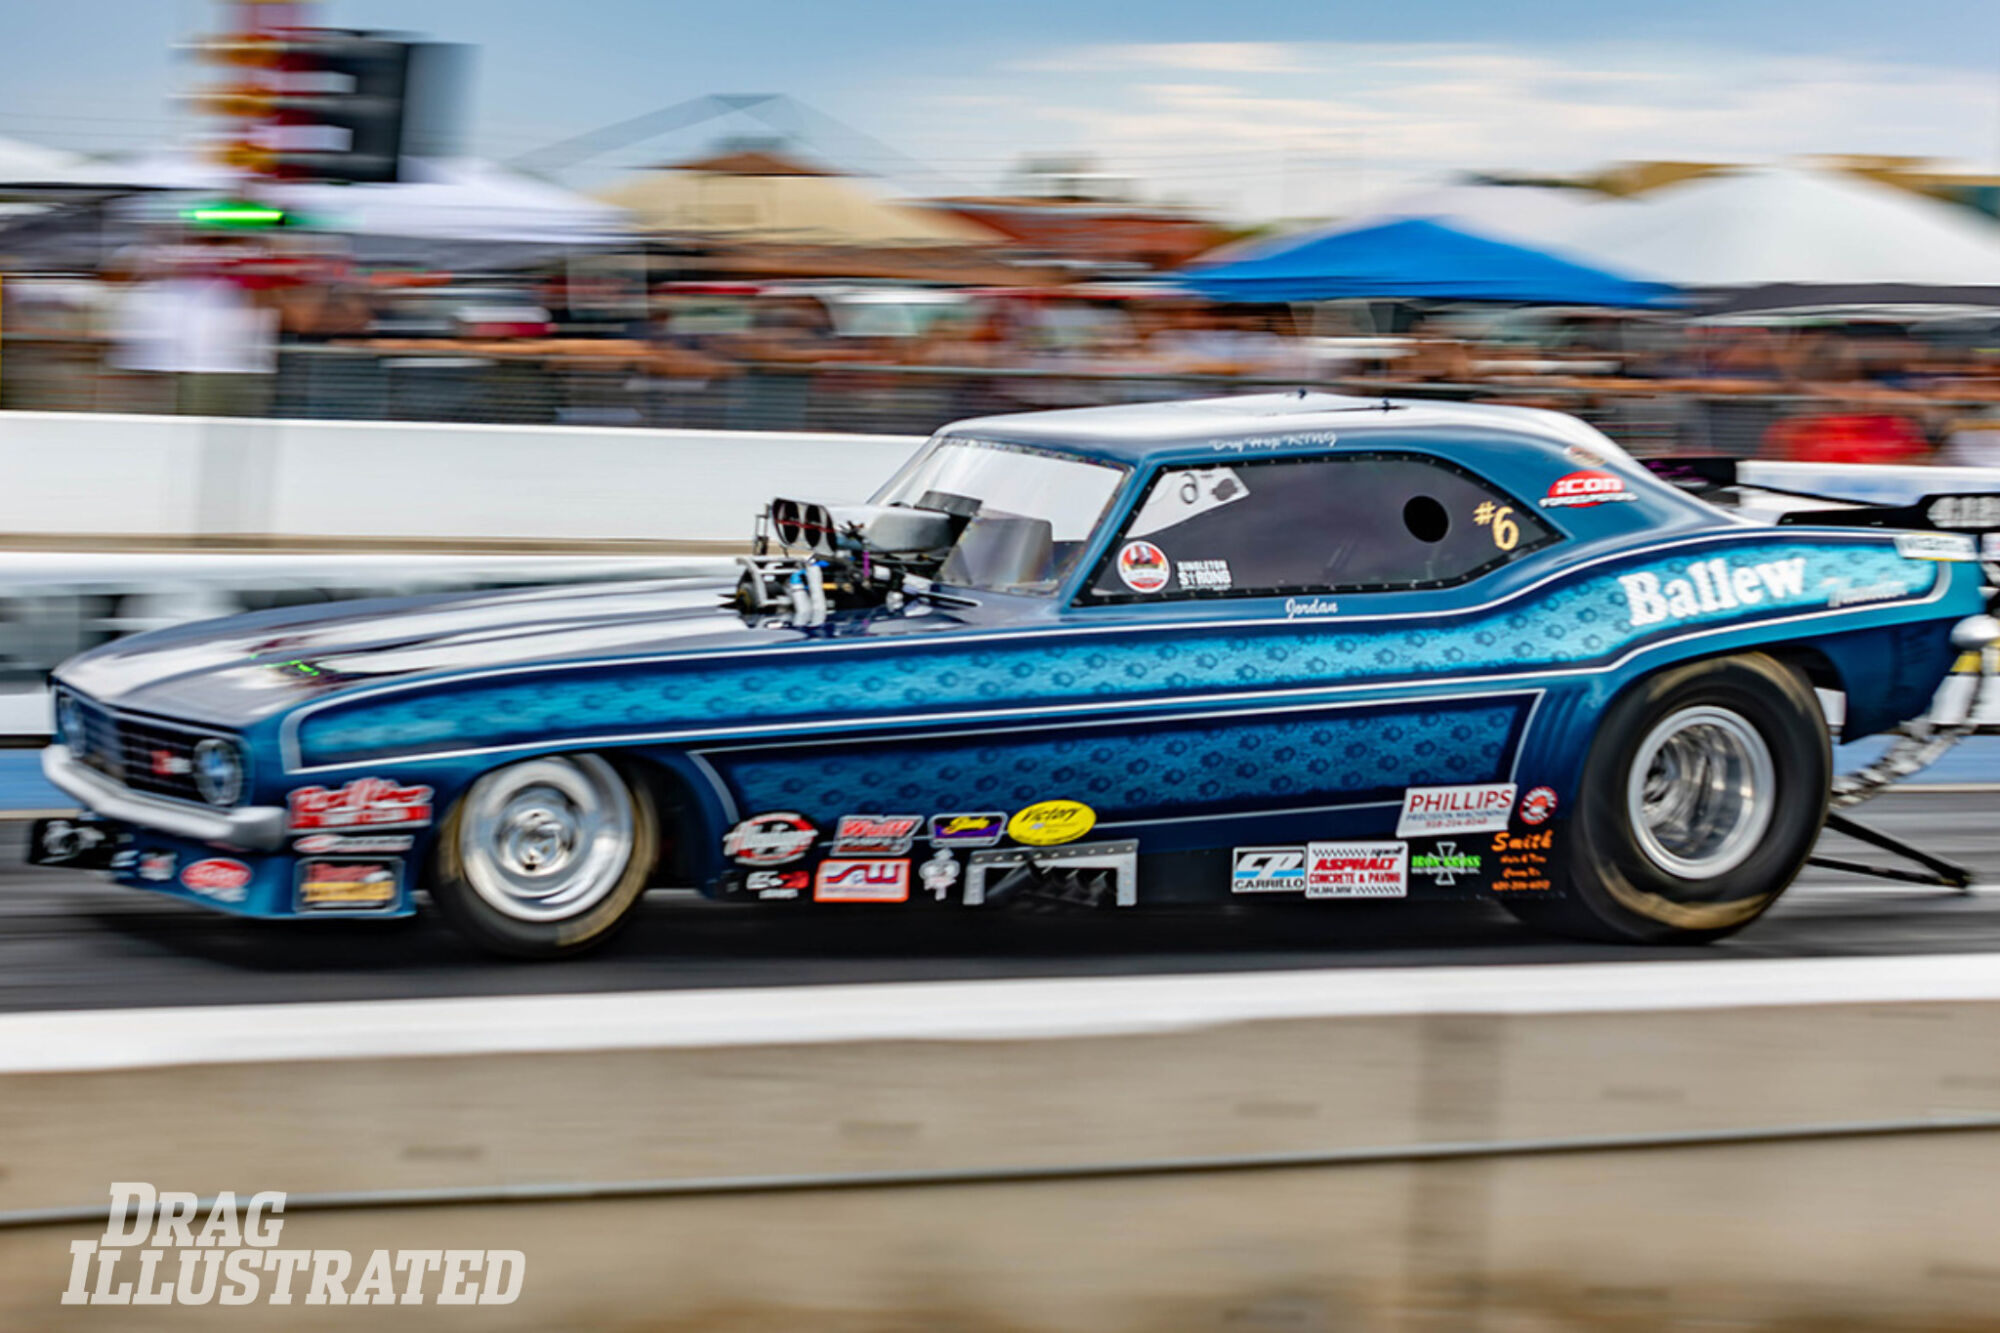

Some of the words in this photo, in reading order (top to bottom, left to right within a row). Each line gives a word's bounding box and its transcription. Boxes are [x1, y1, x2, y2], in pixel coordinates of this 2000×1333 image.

[1178, 569, 1232, 586] STRONG
[1618, 557, 1806, 627] Ballew
[1285, 598, 1338, 621] Jordan
[1409, 789, 1512, 812] PHILLIPS
[1313, 857, 1398, 871] ASPHALT
[1234, 879, 1304, 890] CARRILLO
[1309, 872, 1355, 884] CONCRETE
[1368, 872, 1401, 884] PAVING
